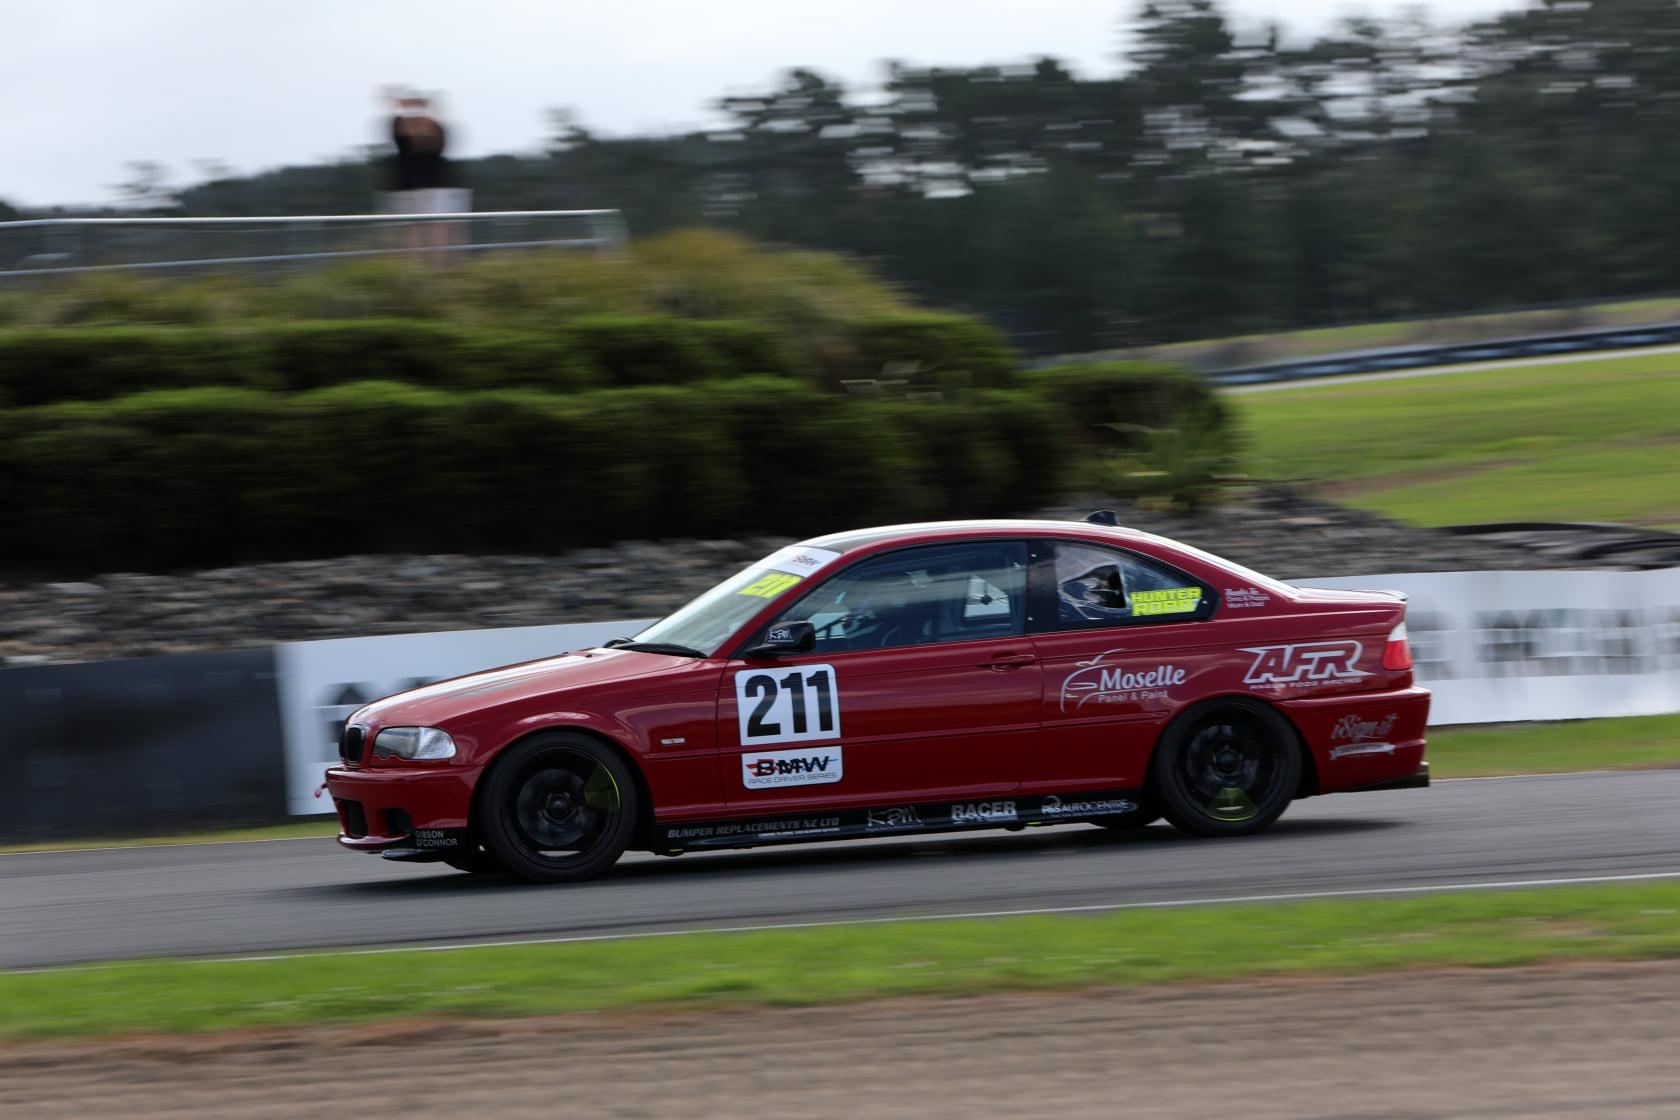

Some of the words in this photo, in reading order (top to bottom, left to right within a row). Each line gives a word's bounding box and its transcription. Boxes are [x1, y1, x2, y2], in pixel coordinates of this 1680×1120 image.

[1131, 587, 1202, 602] HUNTER
[1234, 640, 1379, 683] AFR
[1100, 665, 1185, 691] Moselle
[745, 670, 834, 738] 211
[1098, 692, 1128, 703] Panel
[1130, 692, 1138, 701] &
[1141, 689, 1168, 700] Paint
[756, 755, 829, 777] BMW
[748, 777, 772, 785] RACE
[774, 774, 806, 783] DRIVER
[807, 772, 837, 781] SERIES
[952, 800, 1017, 819] RACER
[667, 827, 714, 839] BUMPER
[715, 820, 801, 836] REPLACEMENTS
[821, 817, 840, 828] LTD
